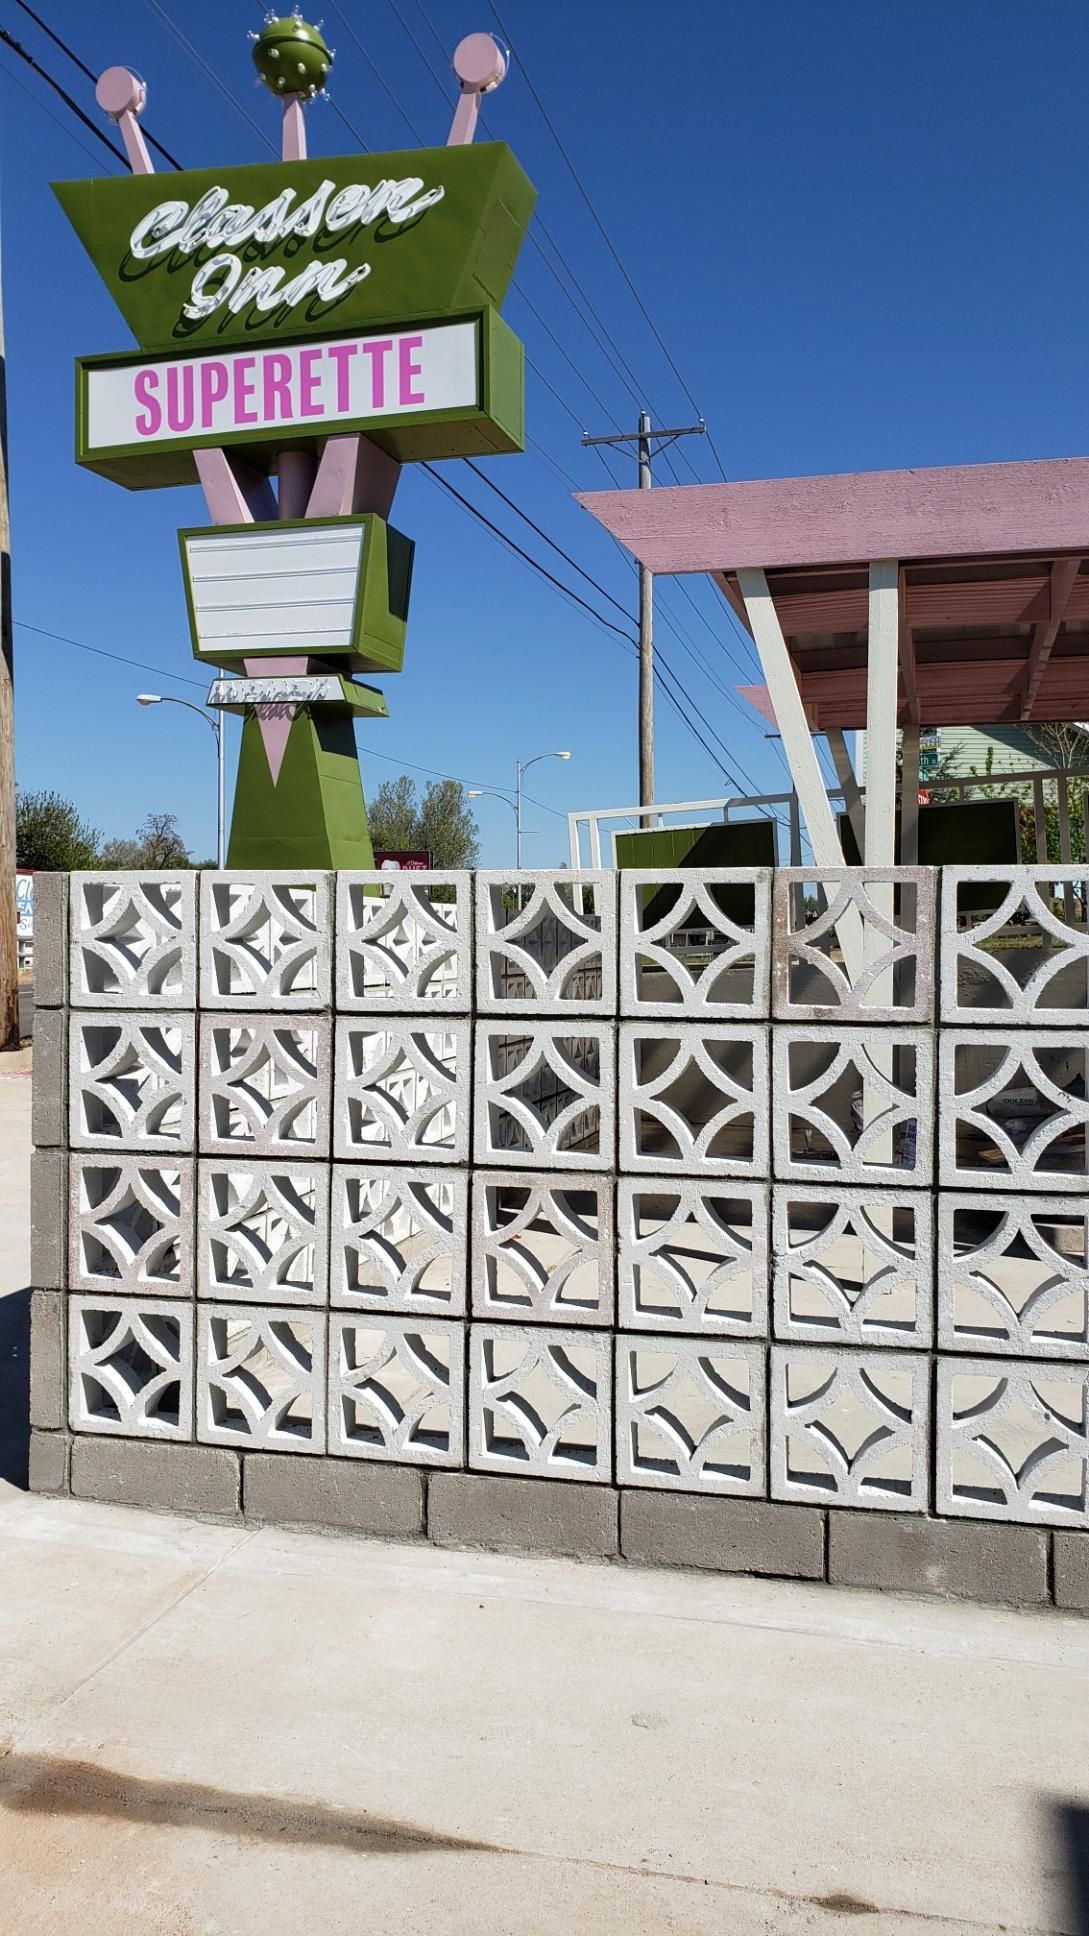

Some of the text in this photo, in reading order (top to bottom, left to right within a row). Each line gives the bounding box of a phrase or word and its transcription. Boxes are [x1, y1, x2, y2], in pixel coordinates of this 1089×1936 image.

[130, 177, 445, 259] Classen
[183, 254, 371, 320] Inn
[134, 336, 425, 436] SUPERETTE
